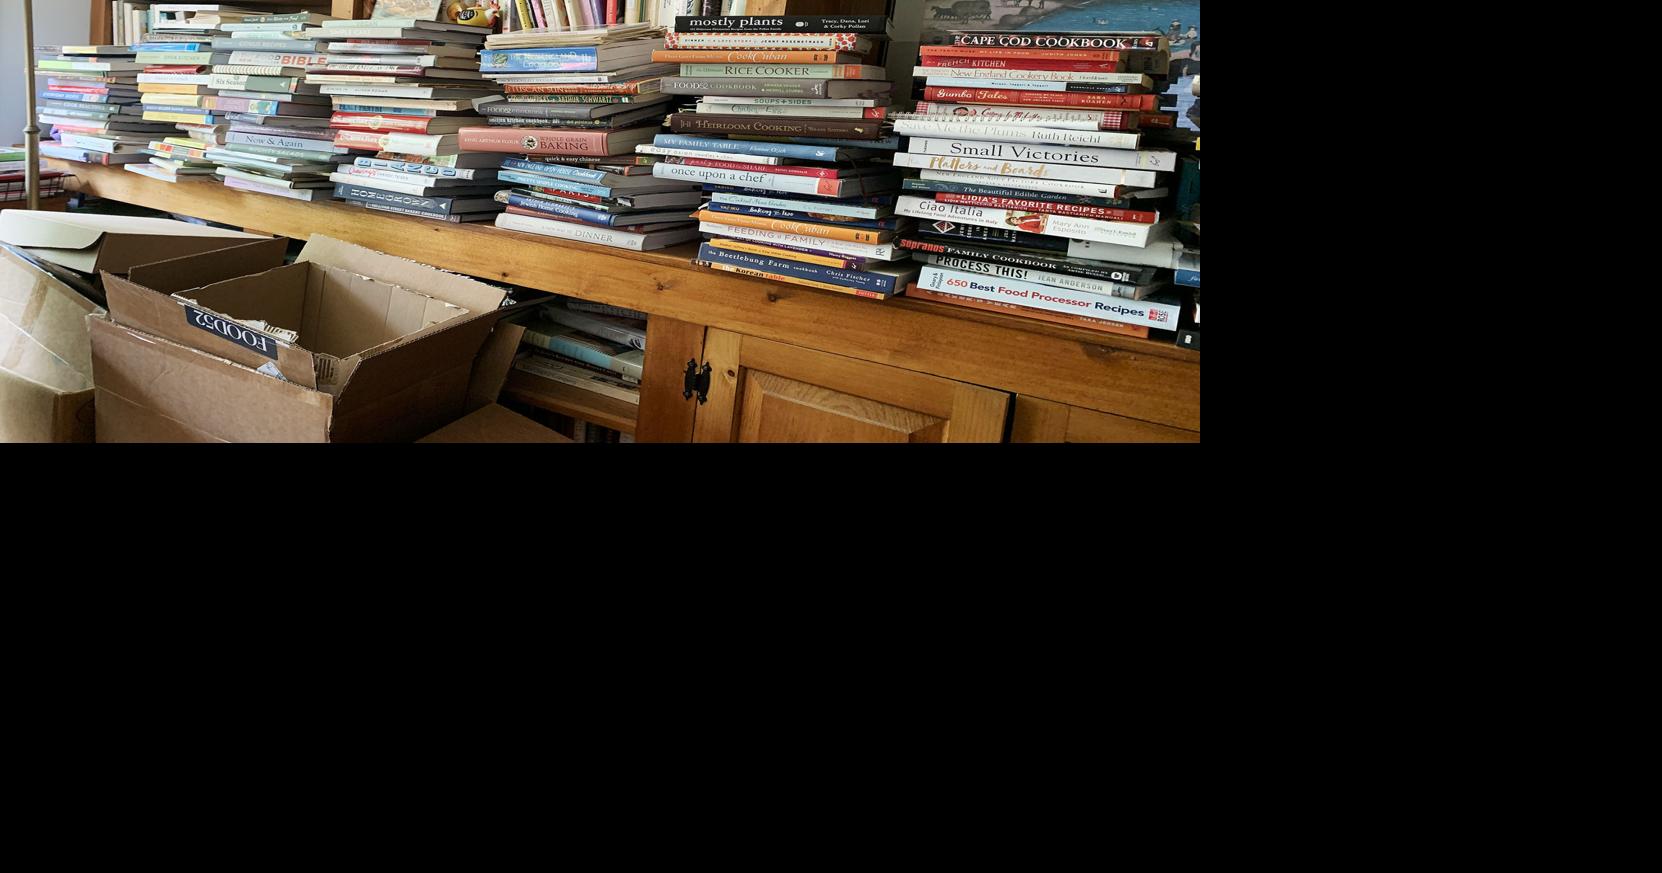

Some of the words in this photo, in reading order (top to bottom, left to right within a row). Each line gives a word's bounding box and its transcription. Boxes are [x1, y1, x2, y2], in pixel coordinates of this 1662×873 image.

[690, 17, 735, 28] mostly
[739, 17, 784, 29] plants
[961, 35, 996, 46] CAPE
[999, 36, 1032, 47] COD
[1035, 37, 1127, 49] COOKBOOK
[281, 55, 327, 65] BIBLE
[971, 60, 1007, 68] KITCHEN
[725, 66, 753, 75] RICE
[756, 66, 810, 76] COOKER
[951, 69, 972, 77] New
[974, 70, 1007, 79] England
[1009, 71, 1048, 82] Cookery
[1049, 73, 1075, 81] Book
[937, 90, 973, 99] Gumbo
[977, 90, 1009, 101] Tales
[695, 120, 751, 131] HEIRLOOM
[753, 121, 802, 132] COOKING
[901, 121, 931, 132] Save
[959, 124, 979, 135] the
[984, 126, 1026, 138] Plums
[1031, 131, 1061, 142] Ruth
[1063, 132, 1102, 144] Reichl
[246, 135, 265, 143] Now
[266, 137, 275, 145] &
[276, 138, 304, 149] Again
[540, 142, 589, 151] BAKING
[678, 140, 710, 148] FAMILY
[712, 142, 740, 150] TABLE
[950, 142, 1002, 157] Small
[1010, 146, 1100, 164] Victories
[929, 156, 979, 172] Platters
[1000, 161, 1048, 178] Boards
[671, 167, 696, 176] once
[698, 169, 726, 181] upon
[738, 173, 768, 183] chef
[979, 187, 1013, 197] Beautiful
[1014, 190, 1040, 199] Edible
[1041, 192, 1067, 201] Garden
[520, 200, 537, 208] Jewish
[537, 203, 554, 211] Home
[554, 206, 579, 217] Cooking
[919, 200, 946, 212] Ciao
[950, 203, 984, 218] Italia
[961, 194, 999, 205] LIDIA'S
[1001, 197, 1054, 210] FAVORITE
[1056, 203, 1106, 215] RECIPES
[948, 214, 977, 222] Adventures
[1052, 219, 1073, 228] Mary
[575, 229, 614, 243] DINNER
[727, 225, 774, 239] FEEDING
[784, 234, 826, 247] FAMILY
[900, 238, 945, 253] sopranos
[947, 247, 990, 259] FAMILY
[992, 254, 1057, 270] COOKBOOK
[719, 251, 765, 266] Beetlebung
[768, 259, 790, 270] Farm
[793, 265, 818, 274] cookbook
[826, 269, 844, 277] Chris
[845, 272, 871, 283] Fischer
[735, 267, 765, 278] Korean
[765, 272, 785, 281] table
[936, 256, 990, 273] PROCESS
[996, 265, 1029, 280] THIS!
[1038, 274, 1060, 283] JEAN
[1061, 277, 1104, 291] ANDERSON
[946, 278, 968, 287] 650
[969, 282, 996, 293] Best
[997, 286, 1029, 299] Food
[1030, 291, 1092, 308] Processor
[1094, 302, 1145, 318] Recipes
[194, 310, 268, 352] FOOD52
